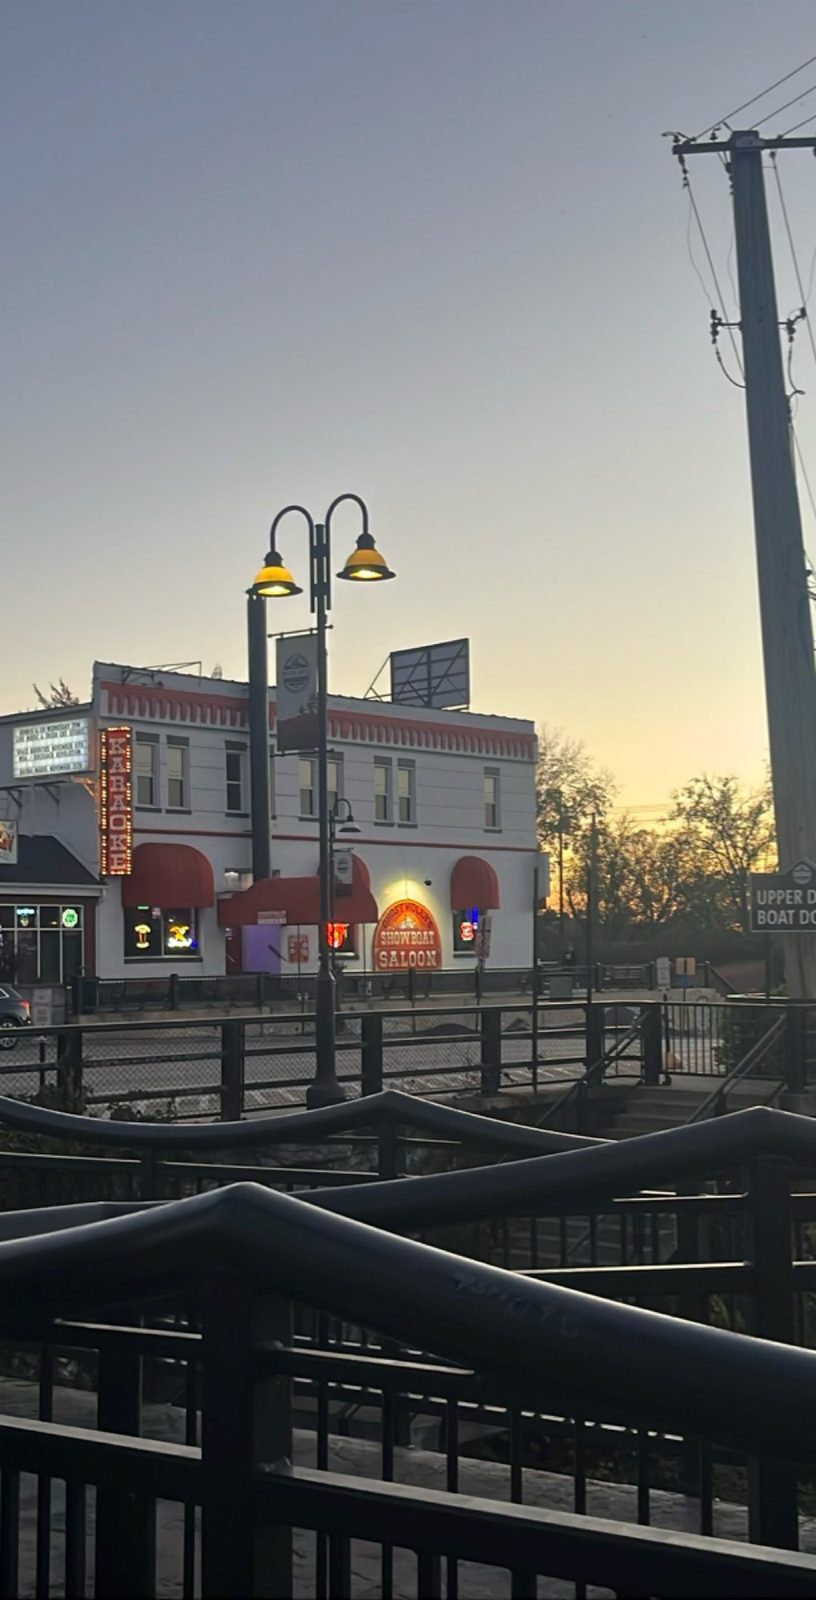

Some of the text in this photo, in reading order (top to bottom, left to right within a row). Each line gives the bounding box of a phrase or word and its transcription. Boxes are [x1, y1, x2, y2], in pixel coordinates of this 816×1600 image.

[109, 738, 127, 869] KARAOKE
[756, 889, 803, 905] UPPER
[757, 909, 795, 925] BOAT
[379, 950, 437, 968] SALOON
